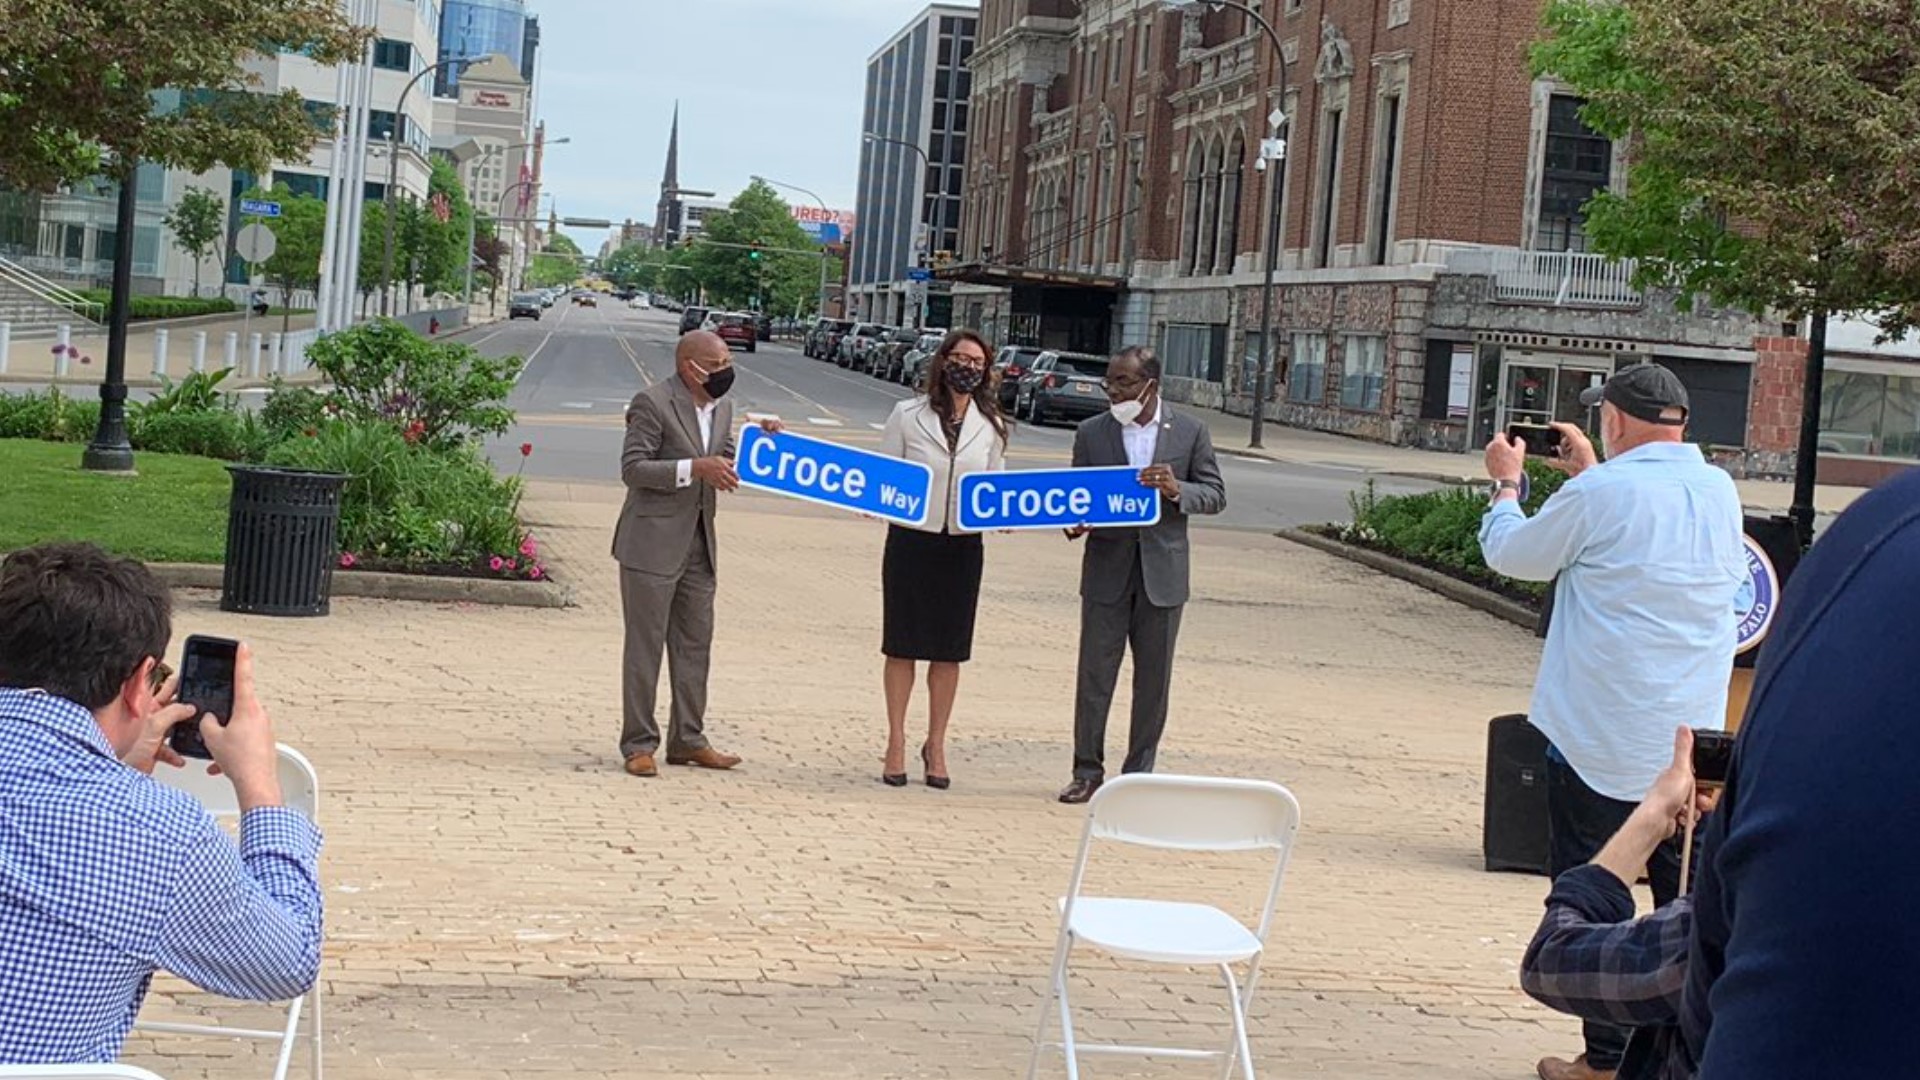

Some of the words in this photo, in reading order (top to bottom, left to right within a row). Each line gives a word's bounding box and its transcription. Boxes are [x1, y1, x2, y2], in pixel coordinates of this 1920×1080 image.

[789, 207, 839, 222] URED?
[750, 436, 866, 498] Croce
[880, 483, 921, 516] Way
[971, 481, 1092, 519] Croce
[1107, 494, 1150, 518] Way
[1738, 602, 1767, 637] FALO
